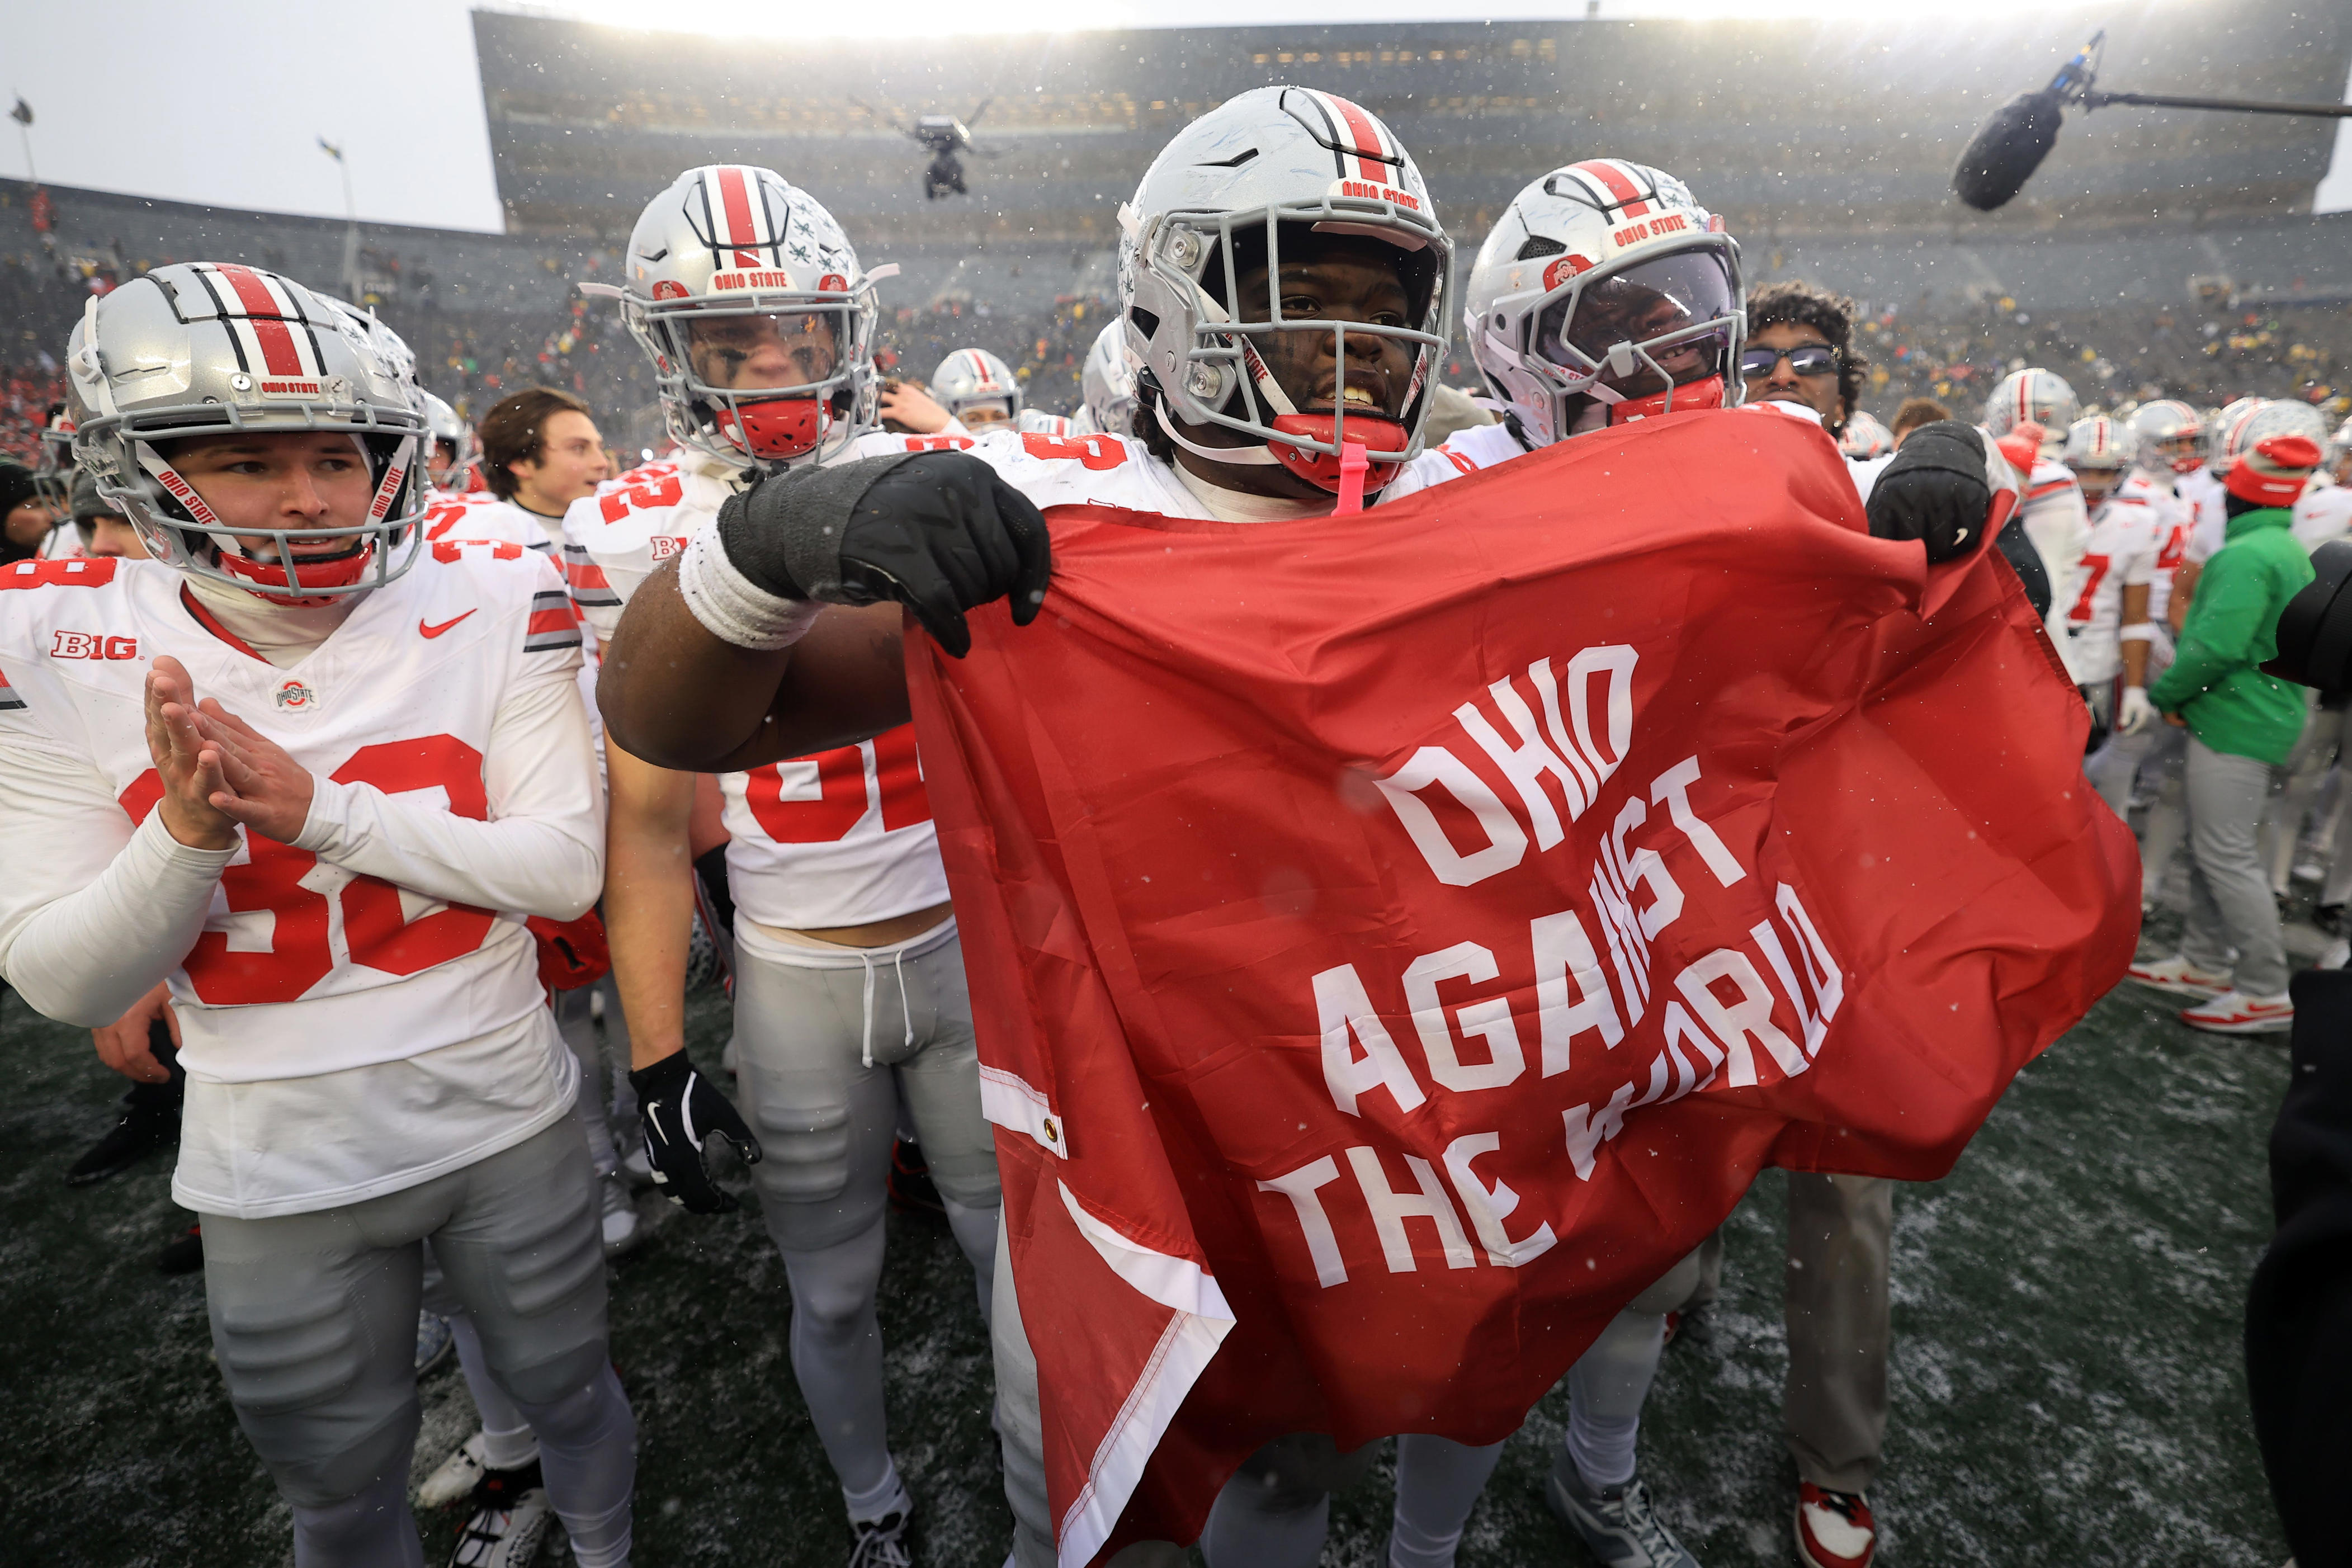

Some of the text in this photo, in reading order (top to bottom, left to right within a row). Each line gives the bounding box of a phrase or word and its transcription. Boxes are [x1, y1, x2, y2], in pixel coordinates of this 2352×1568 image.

[1343, 181, 1419, 210] OHIO STATE
[1614, 215, 1687, 247] OHIO STATE
[714, 272, 787, 290] OHIO STATE
[1244, 347, 1268, 384] STATE
[262, 382, 319, 394] OHIO STATE
[158, 471, 216, 525] OHIO STATE
[371, 466, 403, 518] OHIO STATE
[1372, 644, 1640, 887] OHIO
[1311, 754, 1747, 1117] AGAINST
[1256, 880, 1845, 1288] THE WORLD
